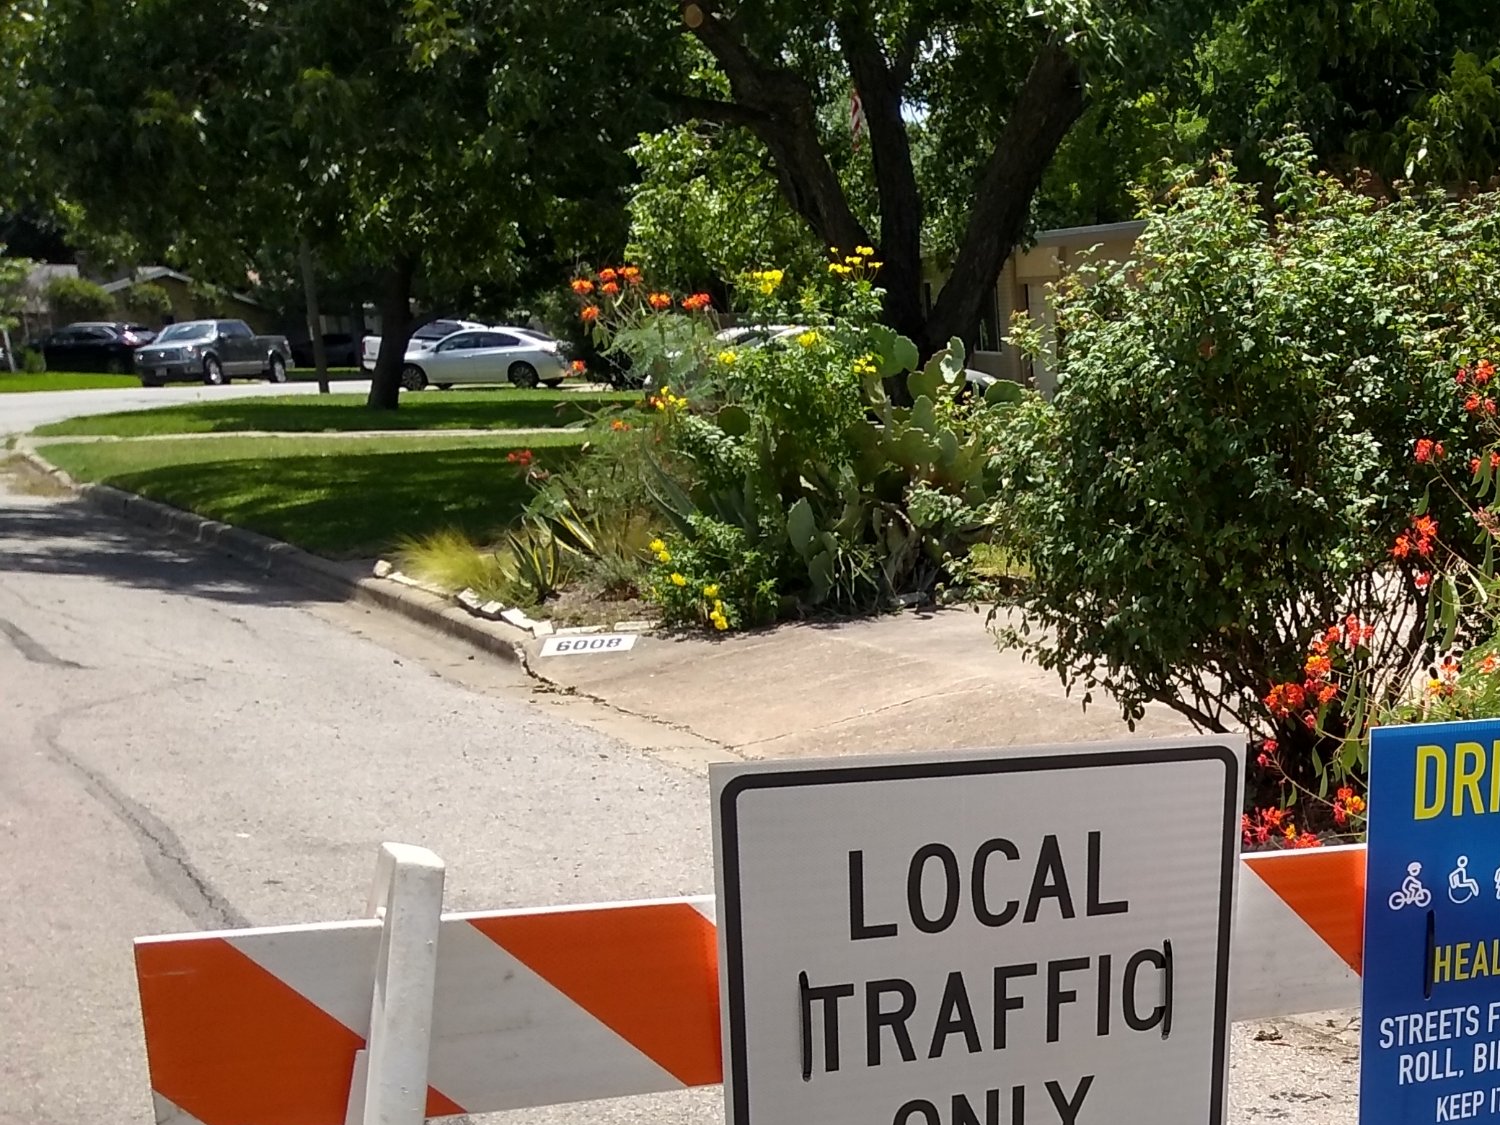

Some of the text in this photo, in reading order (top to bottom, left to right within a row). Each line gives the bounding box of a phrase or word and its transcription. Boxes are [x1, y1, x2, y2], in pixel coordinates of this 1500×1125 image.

[556, 638, 622, 652] 6008
[849, 831, 1129, 940] LOCAL
[809, 948, 1167, 1073] TRAFFIC
[1379, 1006, 1479, 1048] STREETS
[1398, 1048, 1464, 1085] ROLL,
[1437, 1091, 1485, 1122] KEEP
